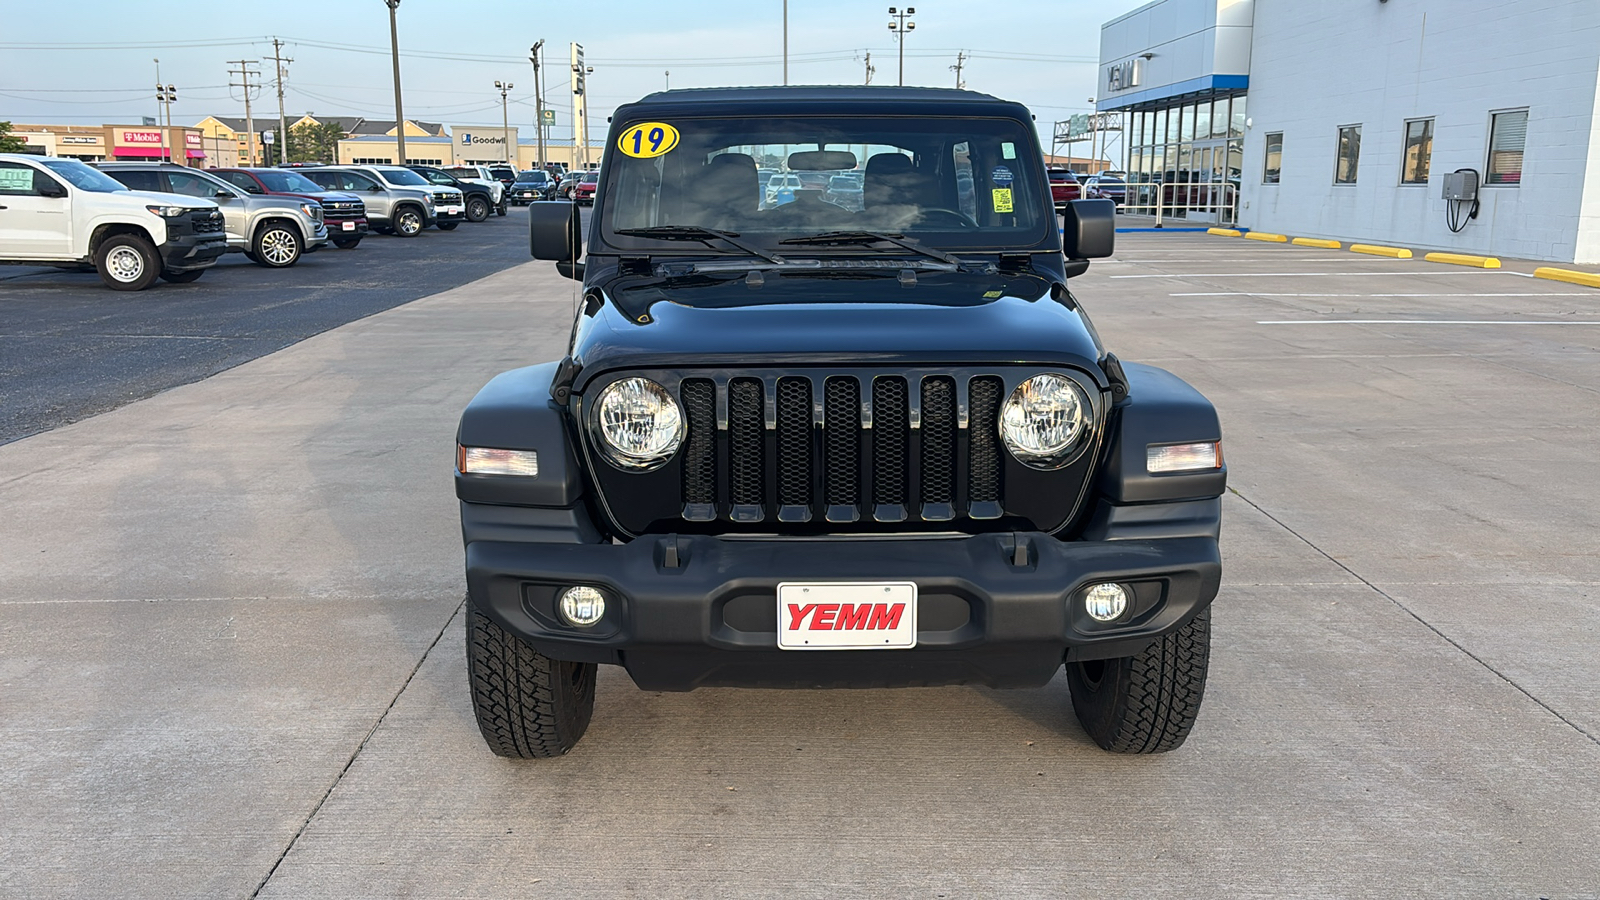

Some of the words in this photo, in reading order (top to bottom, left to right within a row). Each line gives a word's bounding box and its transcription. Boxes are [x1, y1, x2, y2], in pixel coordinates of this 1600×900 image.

[472, 136, 506, 144] Goodwil
[632, 127, 665, 154] 19
[787, 603, 906, 631] YEMM
